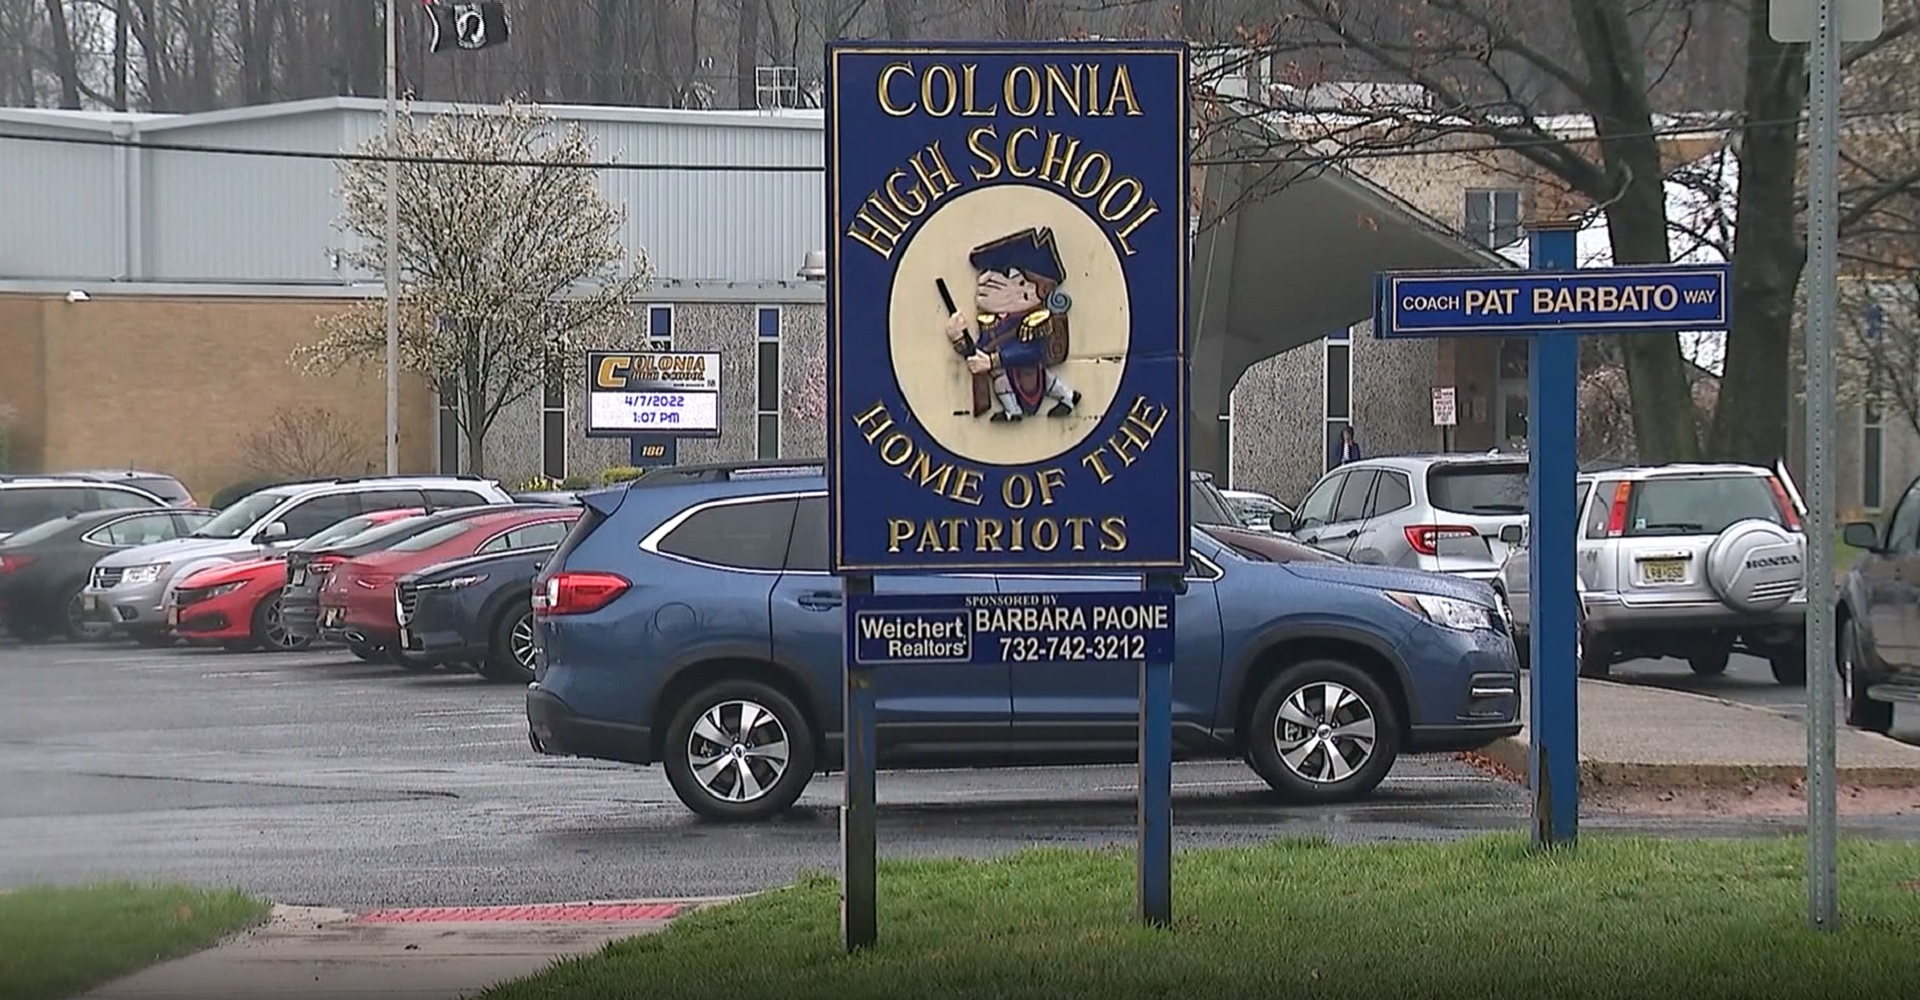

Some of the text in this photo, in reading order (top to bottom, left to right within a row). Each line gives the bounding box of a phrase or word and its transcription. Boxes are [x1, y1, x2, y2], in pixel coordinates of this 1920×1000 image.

[877, 60, 1143, 117] COLONIA
[847, 124, 1160, 260] HIGH SCHOOL
[1402, 284, 1716, 316] COACH PAT BARBATO WAY
[625, 395, 685, 407] 4/7/2022
[633, 412, 680, 423] 1:07 PM
[641, 445, 665, 457] 180
[852, 394, 1169, 509] HOME OF THE
[887, 515, 1129, 552] PATRIOTS
[1746, 555, 1800, 569] HONDA
[965, 594, 1060, 607] SPONSORED BY
[975, 605, 1168, 632] BARBARA PAONE
[1000, 635, 1145, 662] 732-742-3212
